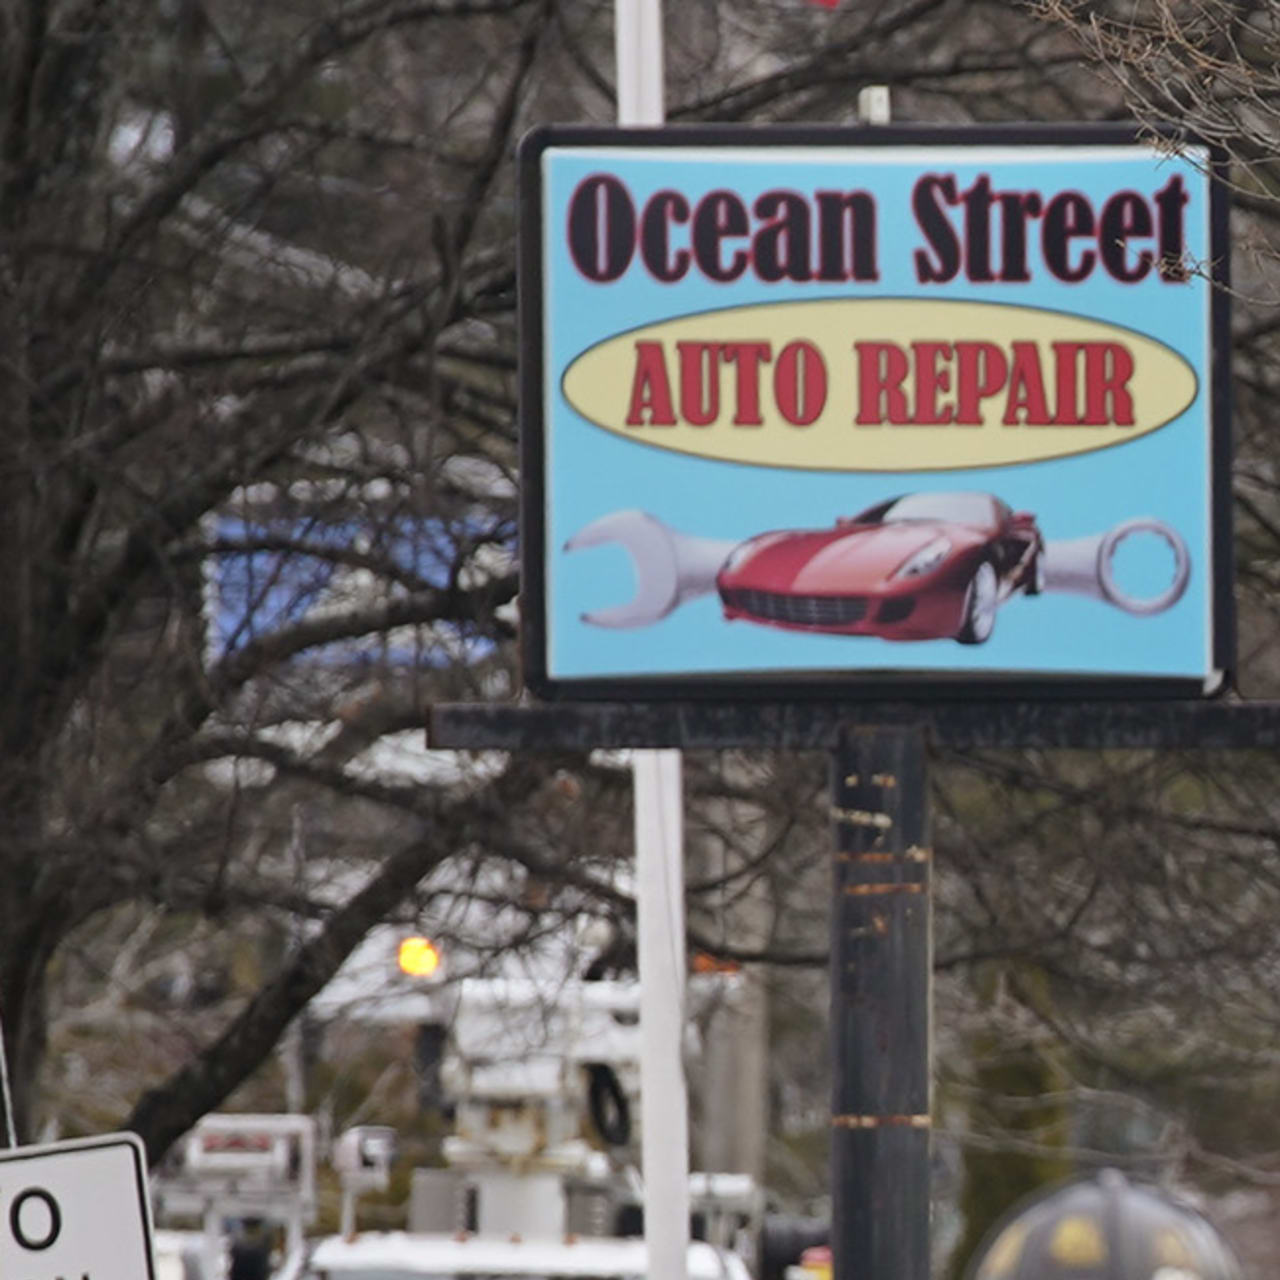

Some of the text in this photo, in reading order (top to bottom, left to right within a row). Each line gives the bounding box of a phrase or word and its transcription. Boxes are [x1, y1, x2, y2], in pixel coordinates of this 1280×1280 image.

[567, 172, 1190, 284] Ocean Street
[625, 339, 1138, 428] AUTO REPAIR
